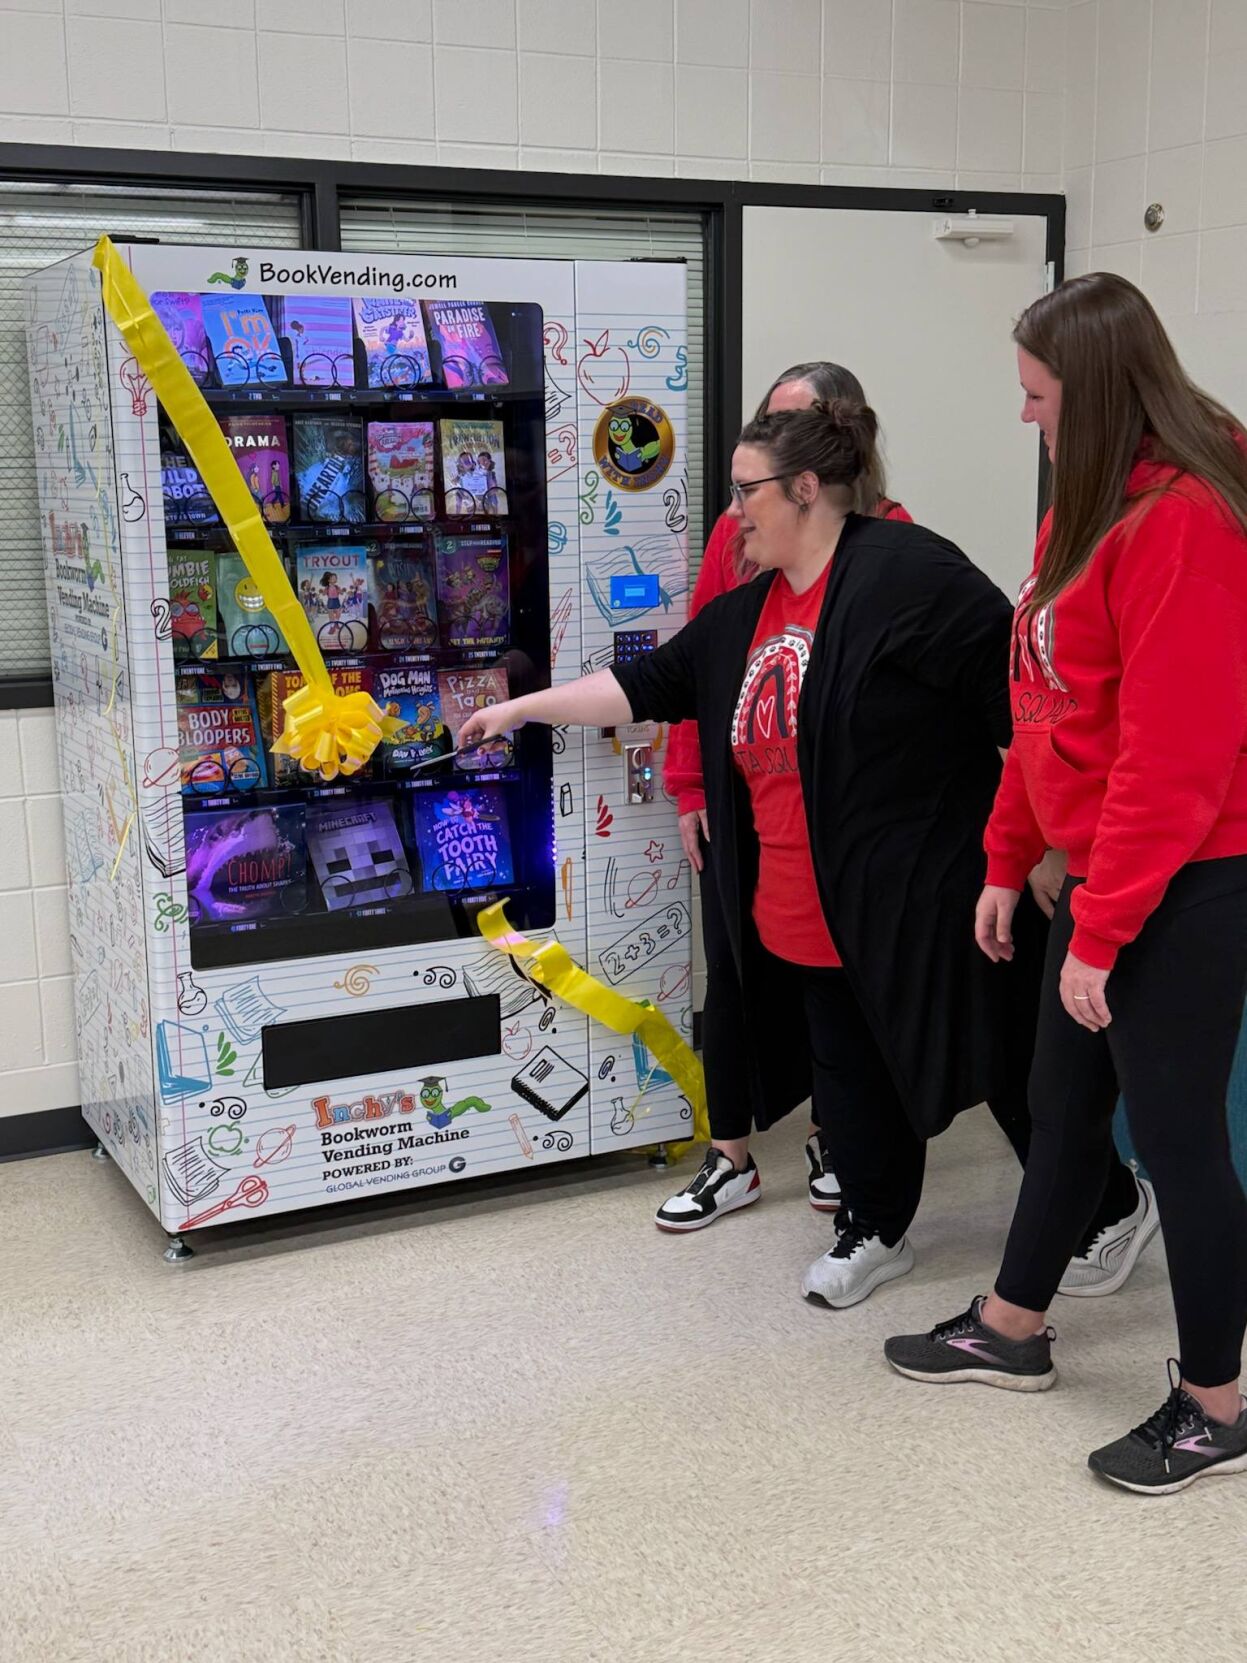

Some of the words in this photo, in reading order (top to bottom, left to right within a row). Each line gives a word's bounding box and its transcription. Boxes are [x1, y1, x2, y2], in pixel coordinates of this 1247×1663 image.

[260, 262, 457, 292] BookVending.com
[220, 310, 270, 337] I'm
[433, 307, 486, 325] PARADISE
[456, 323, 482, 338] FIRE
[223, 435, 280, 447] DRAMA
[162, 484, 205, 499] OBOT
[306, 453, 346, 509] UNEARTHE
[168, 560, 209, 578] MBIE
[303, 554, 360, 568] TRYOUT
[169, 576, 209, 589] OLDFISH
[341, 671, 362, 684] THE
[380, 672, 405, 688] DOG
[407, 670, 431, 685] MAN
[188, 709, 230, 730] BODY
[179, 728, 250, 746] BLOOPERS
[736, 750, 765, 774] TA
[764, 746, 798, 775] SQU
[319, 811, 377, 833] MINECRAFT
[436, 820, 477, 845] CATCH
[477, 822, 494, 831] THE
[438, 834, 498, 861] TOOTH
[312, 1090, 415, 1130] Inchy's
[321, 1122, 413, 1146] Bookworm
[322, 1143, 393, 1163] Vending
[398, 1129, 470, 1150] Machine
[322, 1160, 390, 1181] POWERED
[395, 1156, 413, 1167] BY:
[326, 1181, 365, 1193] GLOBAL
[365, 1171, 410, 1186] VENDING
[412, 1165, 446, 1178] GROUP
